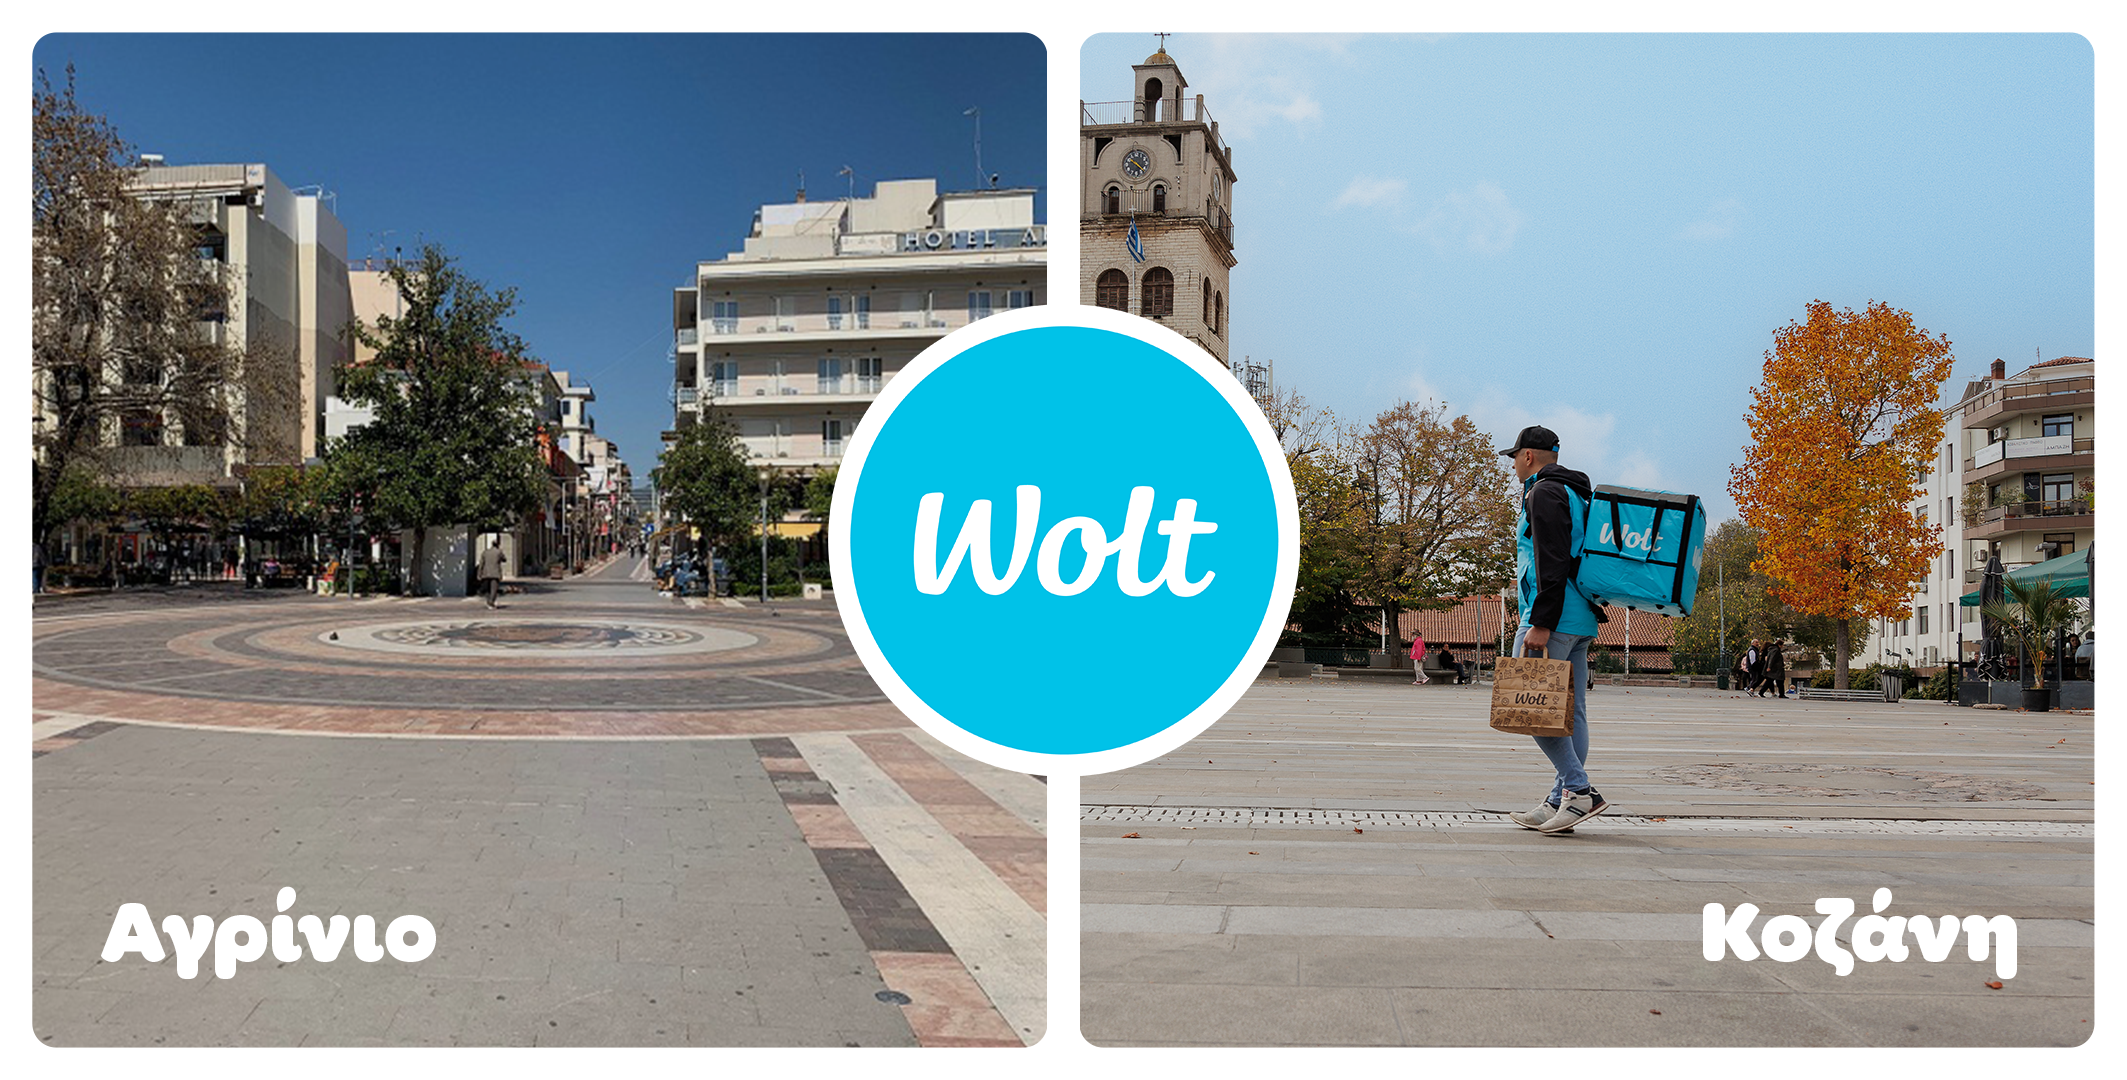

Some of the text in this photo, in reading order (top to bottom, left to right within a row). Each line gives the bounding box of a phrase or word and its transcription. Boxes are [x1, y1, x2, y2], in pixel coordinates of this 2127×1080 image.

[905, 229, 996, 247] HOTEL
[1021, 226, 1047, 242] A
[1600, 523, 1663, 552] Wolt
[1515, 692, 1548, 705] Wolt
